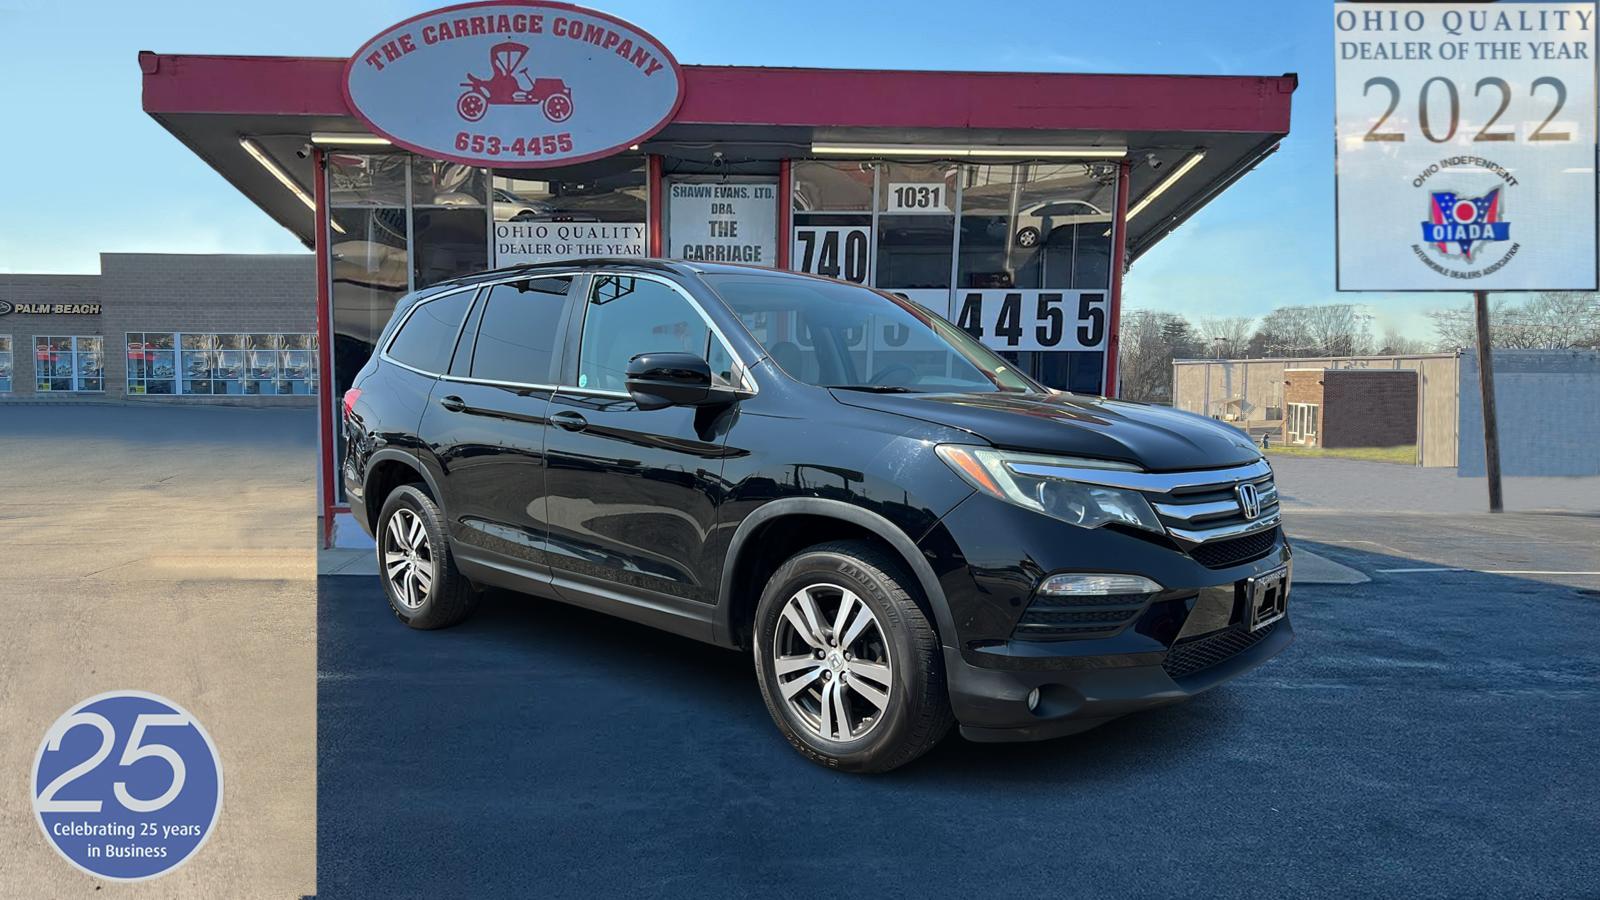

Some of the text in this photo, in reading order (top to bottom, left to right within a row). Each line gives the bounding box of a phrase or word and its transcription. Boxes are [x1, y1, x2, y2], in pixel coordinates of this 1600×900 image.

[1336, 10, 1592, 35] OHIO QUALITY
[365, 14, 664, 77] THE CARRIAGE COMPANY
[1340, 41, 1589, 60] DEALER OF THE YEAR
[1363, 76, 1571, 143] 2022
[454, 131, 574, 157] 653-4455
[1412, 155, 1519, 188] OHIO INDEPENDENT
[672, 185, 712, 198] SHAWN
[753, 187, 775, 200] LTD.
[894, 186, 941, 209] 1031
[711, 203, 736, 215] DBA.
[497, 225, 644, 241] OHIO QUALITY
[708, 220, 738, 238] THE
[1432, 224, 1496, 241] OIADA
[499, 243, 642, 255] DEALER OF THE YEAR
[683, 244, 763, 263] CARRIAGE
[797, 229, 868, 285] 740
[1449, 269, 1482, 280] DEALERS
[14, 303, 51, 315] PALM
[53, 303, 101, 315] BEACH
[957, 292, 1105, 348] 4455
